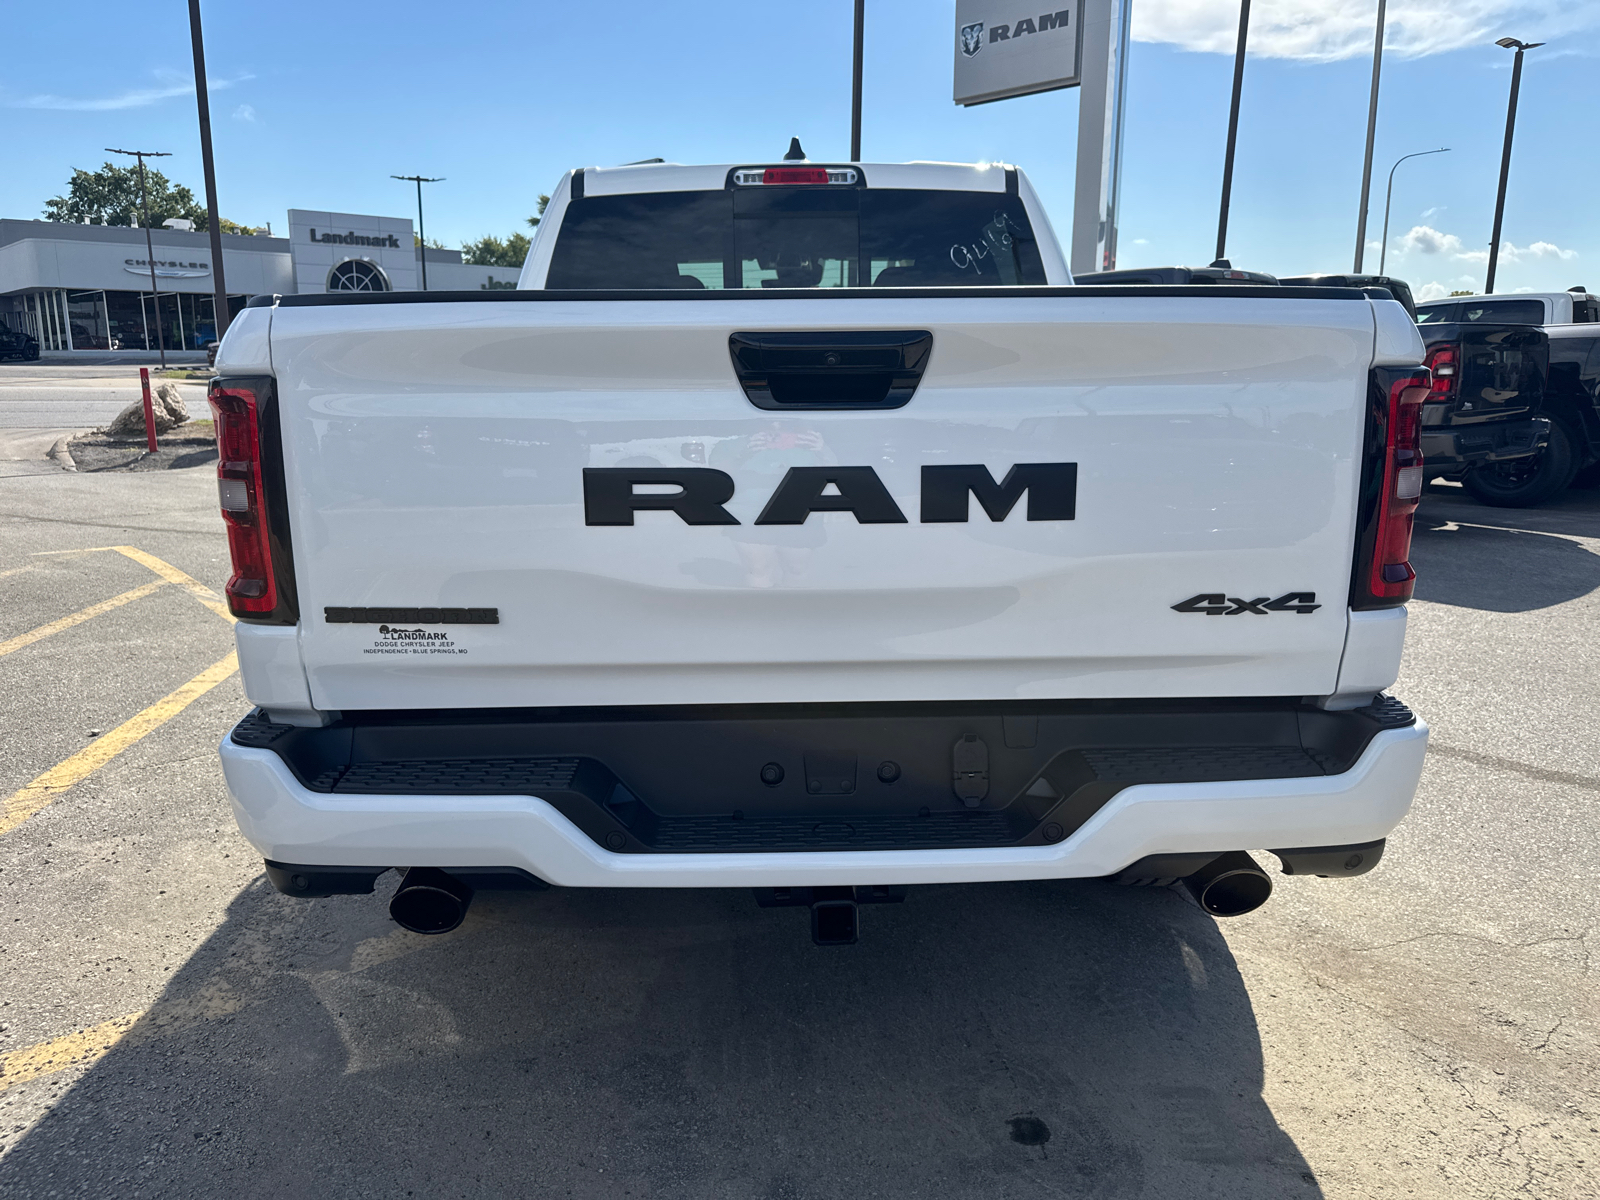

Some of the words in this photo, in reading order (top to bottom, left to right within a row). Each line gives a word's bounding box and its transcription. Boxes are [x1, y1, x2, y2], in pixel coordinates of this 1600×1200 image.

[989, 10, 1069, 44] RAM
[310, 228, 400, 248] Landmark
[124, 259, 208, 269] CHRYSLER
[582, 462, 1077, 526] RAM
[1170, 592, 1322, 615] 4x4
[391, 632, 448, 640] LANDMARK
